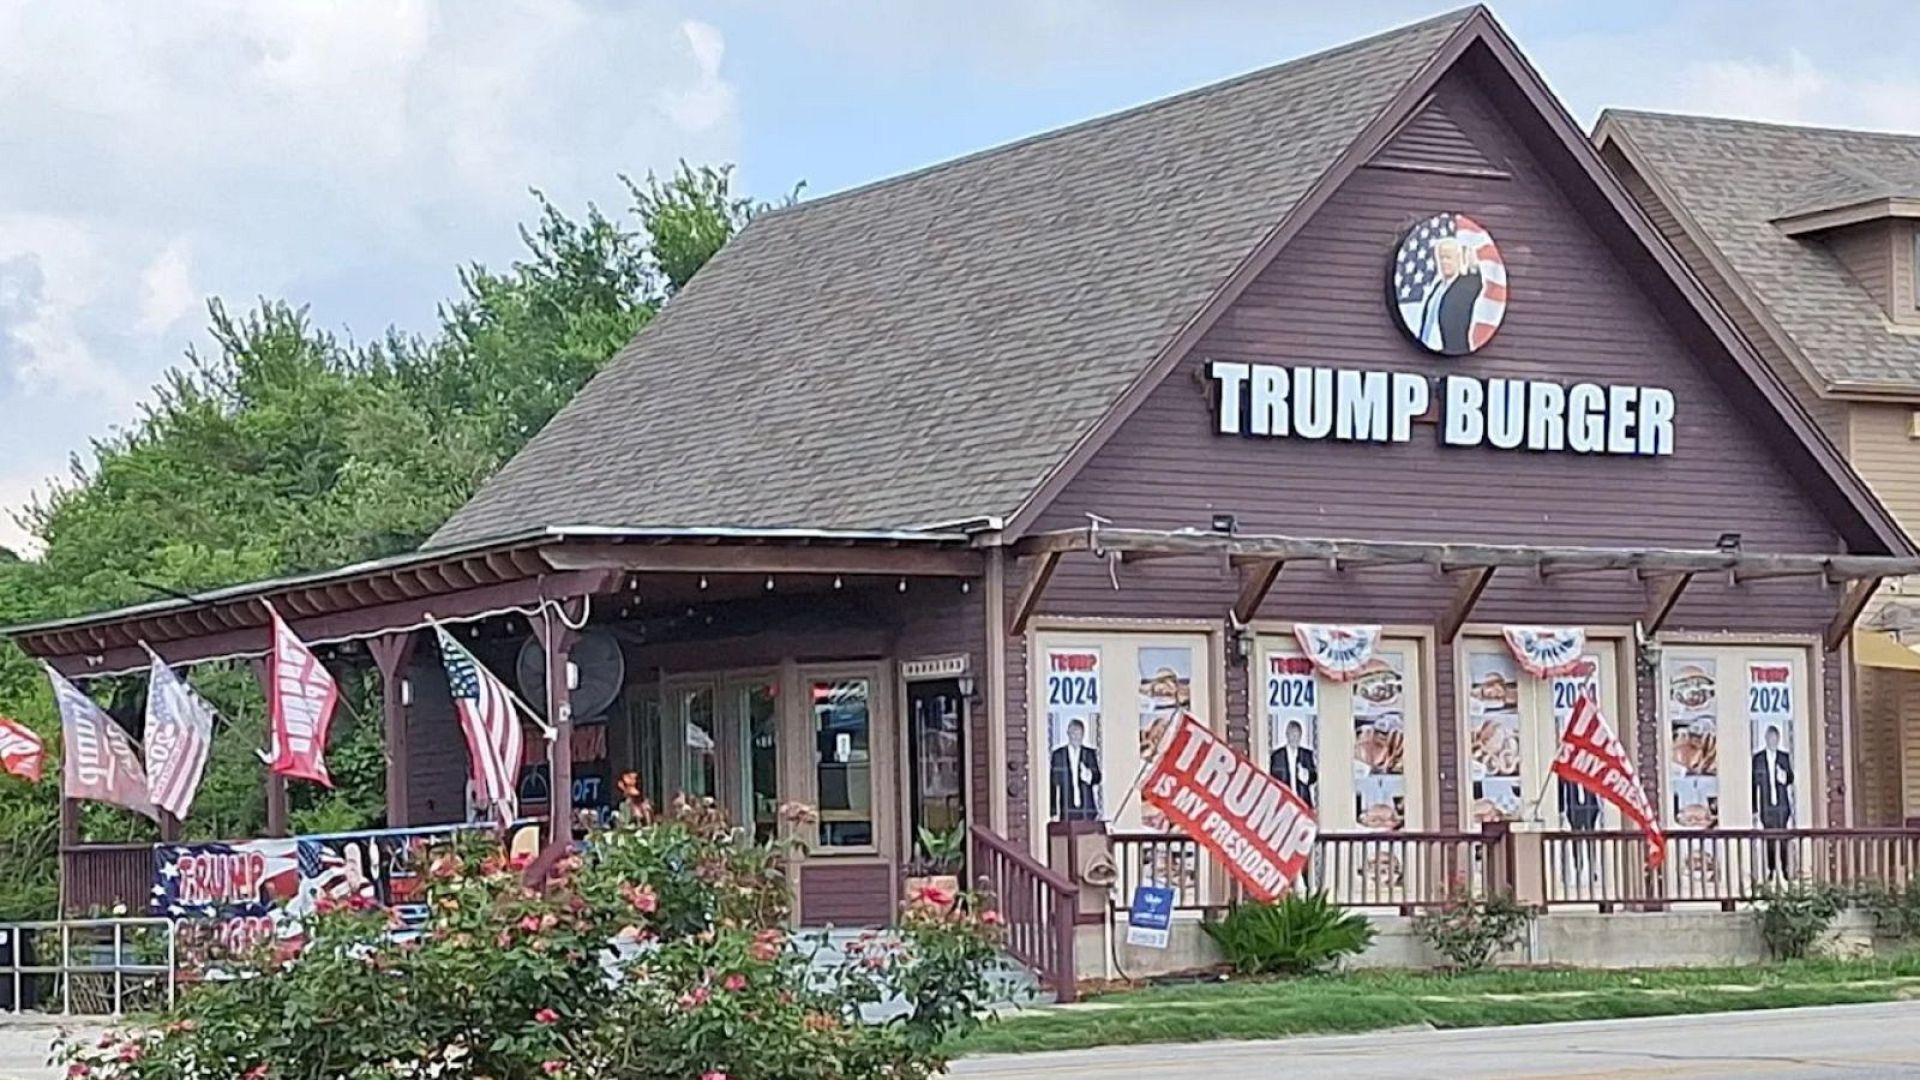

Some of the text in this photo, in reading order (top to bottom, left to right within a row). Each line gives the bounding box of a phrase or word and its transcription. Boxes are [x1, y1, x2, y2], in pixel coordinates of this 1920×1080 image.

[1212, 361, 1675, 455] TRUMP BURGER
[1049, 653, 1097, 672] TRUMP
[1049, 676, 1098, 705] 2024
[1269, 679, 1315, 707] 2024
[1750, 686, 1790, 713] 2024
[1571, 748, 1607, 777] MY
[1175, 720, 1317, 863] TRUMP
[1152, 772, 1291, 897] IS MY PRESIDENT
[178, 850, 266, 905] TRUMP
